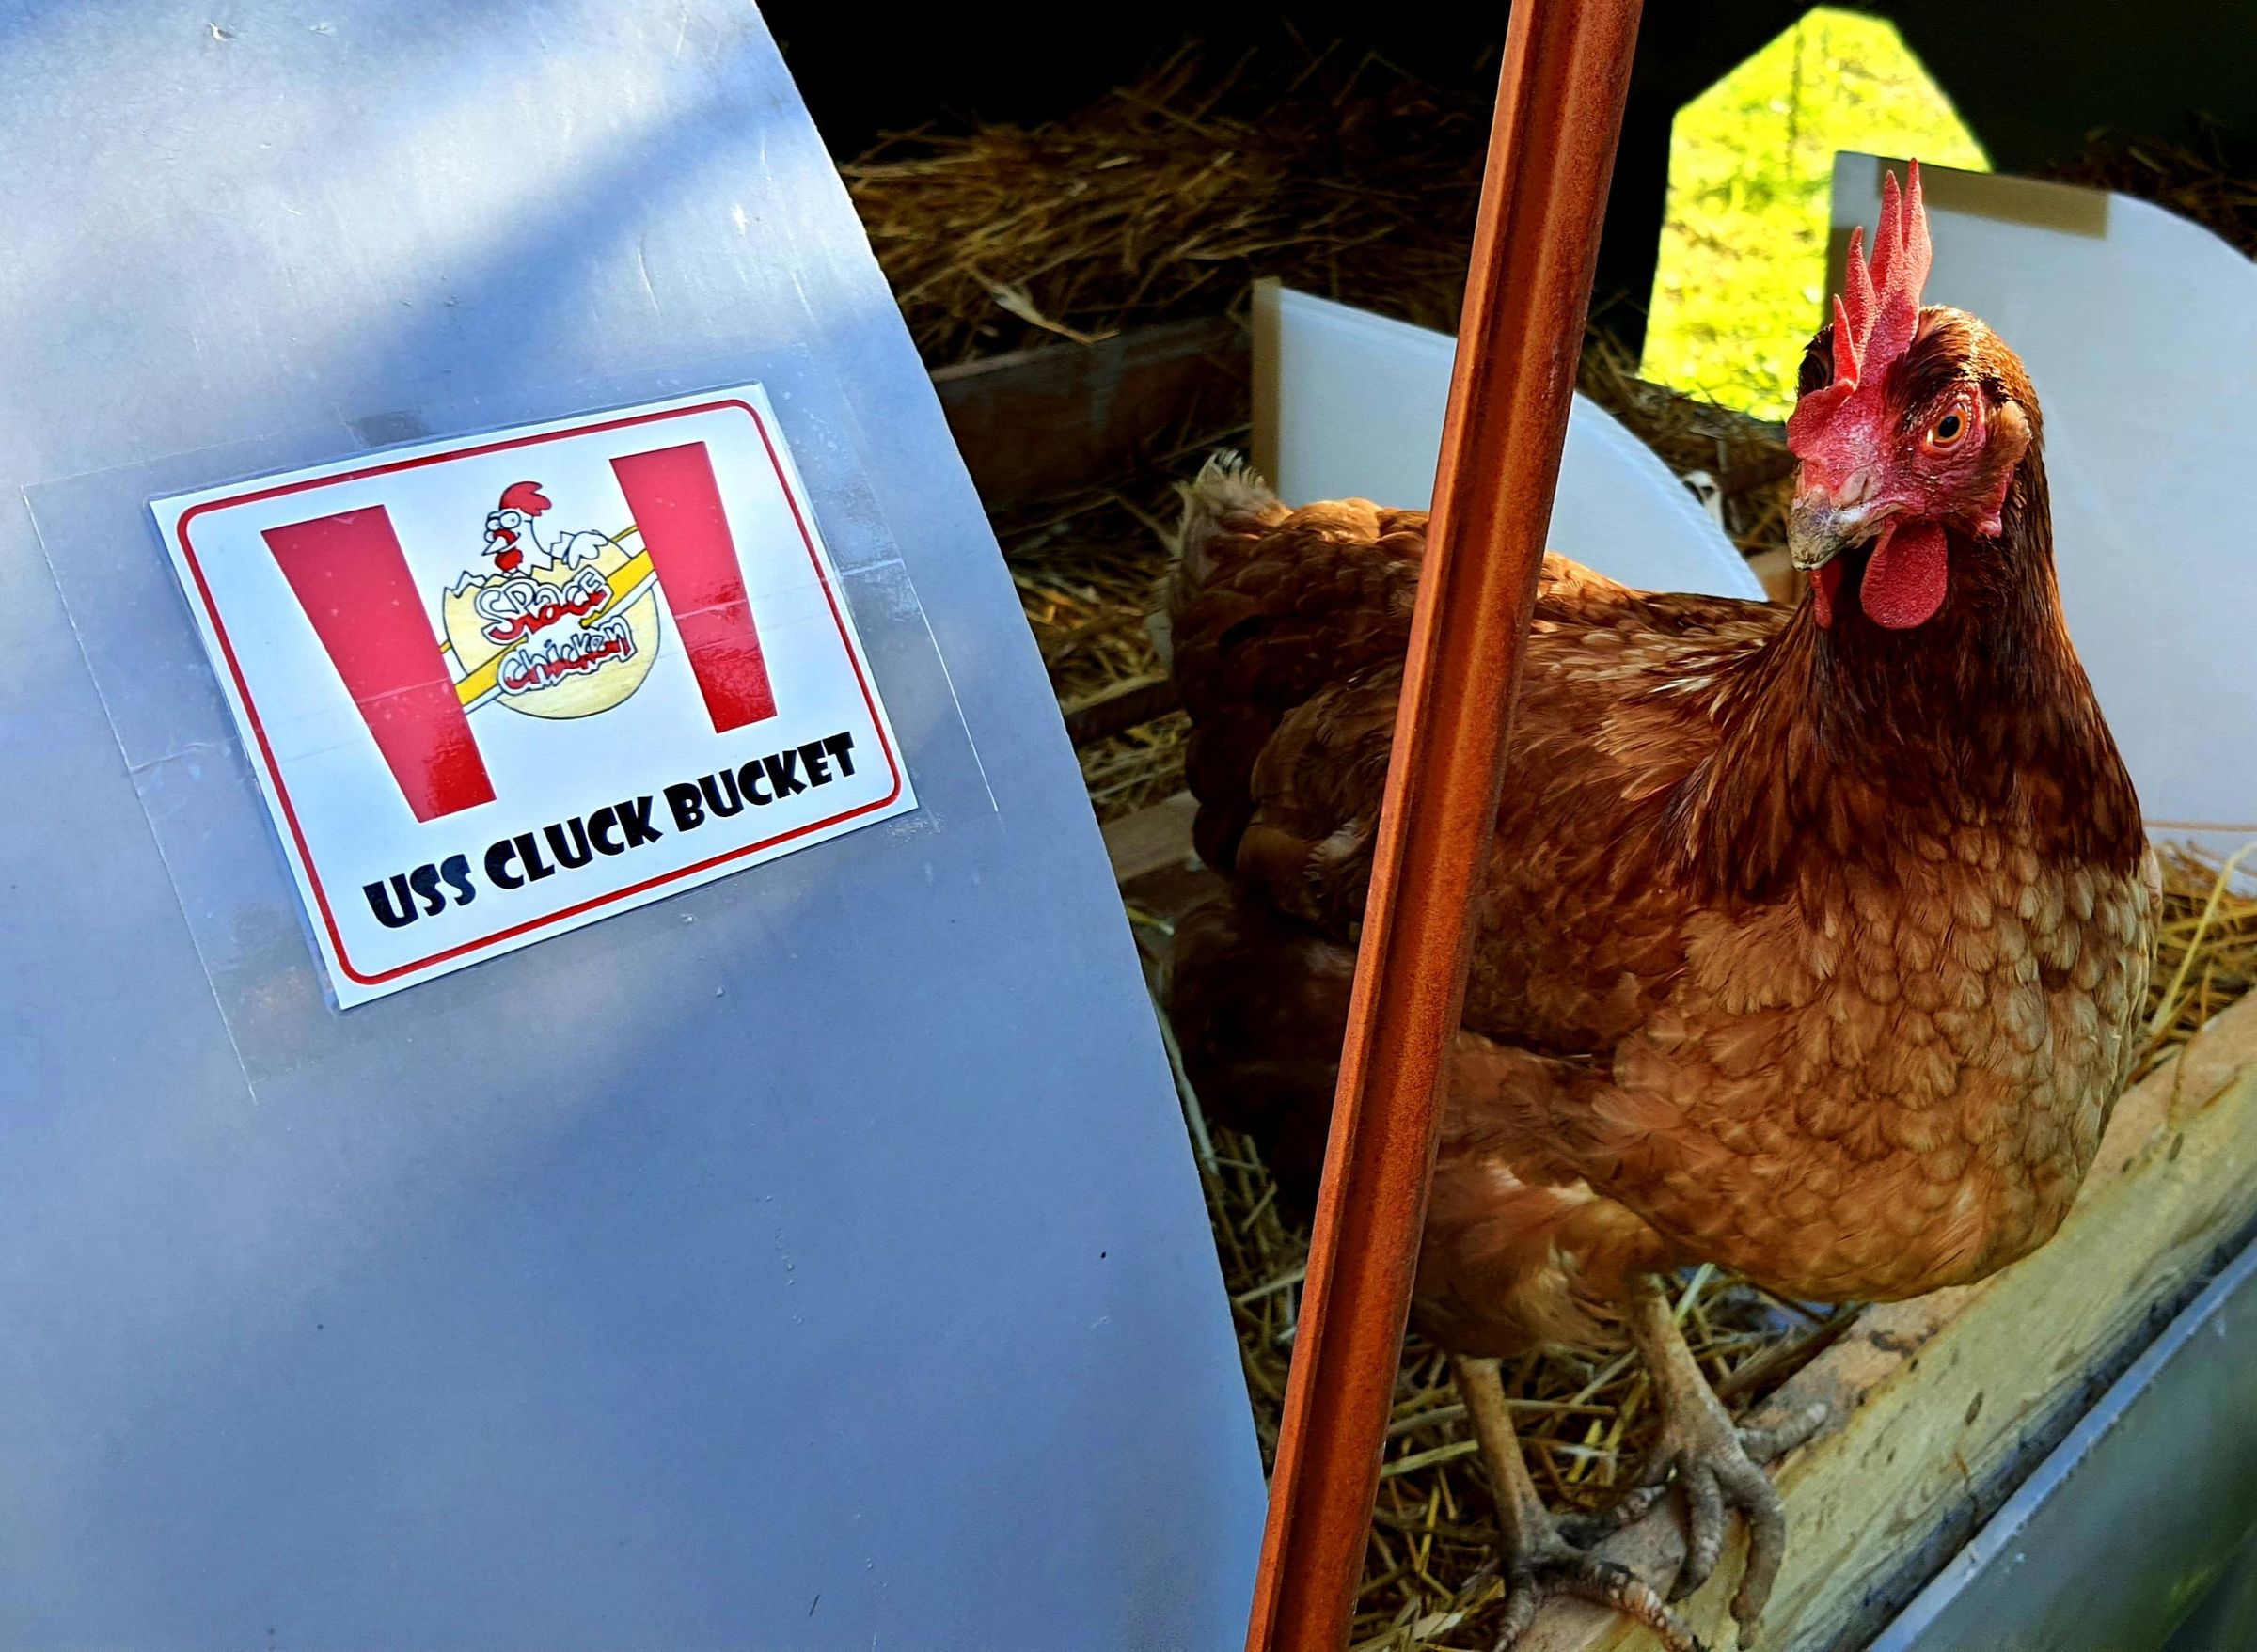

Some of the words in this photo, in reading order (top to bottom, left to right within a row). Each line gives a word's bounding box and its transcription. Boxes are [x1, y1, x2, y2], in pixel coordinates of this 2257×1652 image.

[500, 619, 635, 693] Chicken
[362, 853, 477, 929] USS
[483, 795, 664, 890] CLUCK
[662, 731, 856, 833] BUCKET
